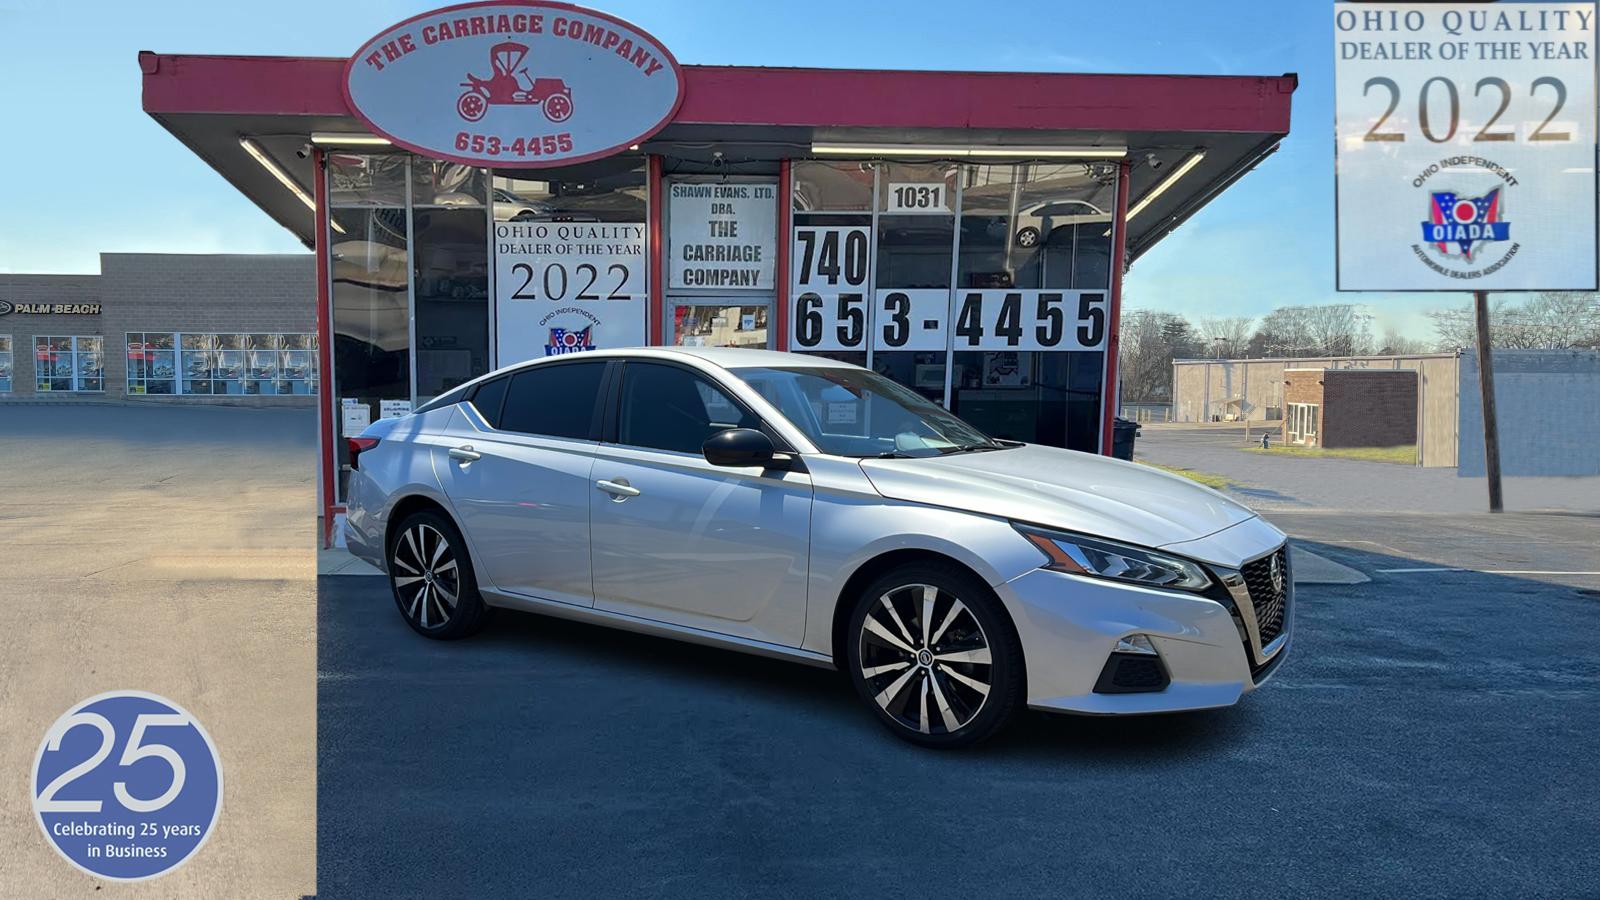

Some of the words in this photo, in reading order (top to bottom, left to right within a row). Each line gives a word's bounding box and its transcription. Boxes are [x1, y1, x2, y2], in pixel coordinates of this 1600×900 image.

[1336, 10, 1425, 31] OHIO
[1442, 10, 1592, 35] QUALITY
[366, 34, 415, 71] THE
[423, 15, 543, 45] CARRIAGE
[553, 17, 663, 76] COMPANY
[1340, 42, 1432, 60] DEALER
[1439, 42, 1469, 60] OF
[1475, 42, 1522, 60] THE
[1528, 42, 1589, 60] YEAR
[1363, 76, 1571, 143] 2022
[455, 131, 573, 157] 653-4455
[1412, 164, 1440, 188] OHIO
[1439, 155, 1519, 188] INDEPENDENT
[672, 185, 712, 198] SHAWN
[754, 187, 774, 200] LTD.
[894, 186, 940, 208] 1031
[711, 203, 736, 215] DBA.
[497, 225, 548, 239] OHIO
[557, 226, 643, 240] QUALITY
[708, 221, 738, 237] THE
[1432, 223, 1495, 240] OIADA
[500, 243, 552, 255] DEALER
[555, 243, 573, 255] OF
[576, 243, 603, 255] THE
[606, 243, 641, 256] YEAR
[683, 244, 762, 263] CARRIAGE
[797, 230, 868, 285] 740
[1411, 243, 1450, 277] AUTOMOBILE
[1450, 268, 1483, 280] DEALERS
[1482, 242, 1521, 277] ASSOCIATION
[511, 262, 632, 301] 2022
[683, 268, 761, 287] COMPANY
[15, 303, 51, 314] PALM
[54, 303, 100, 314] BEACH
[539, 313, 555, 326] OHIO
[555, 307, 601, 326] INDEPENDENT
